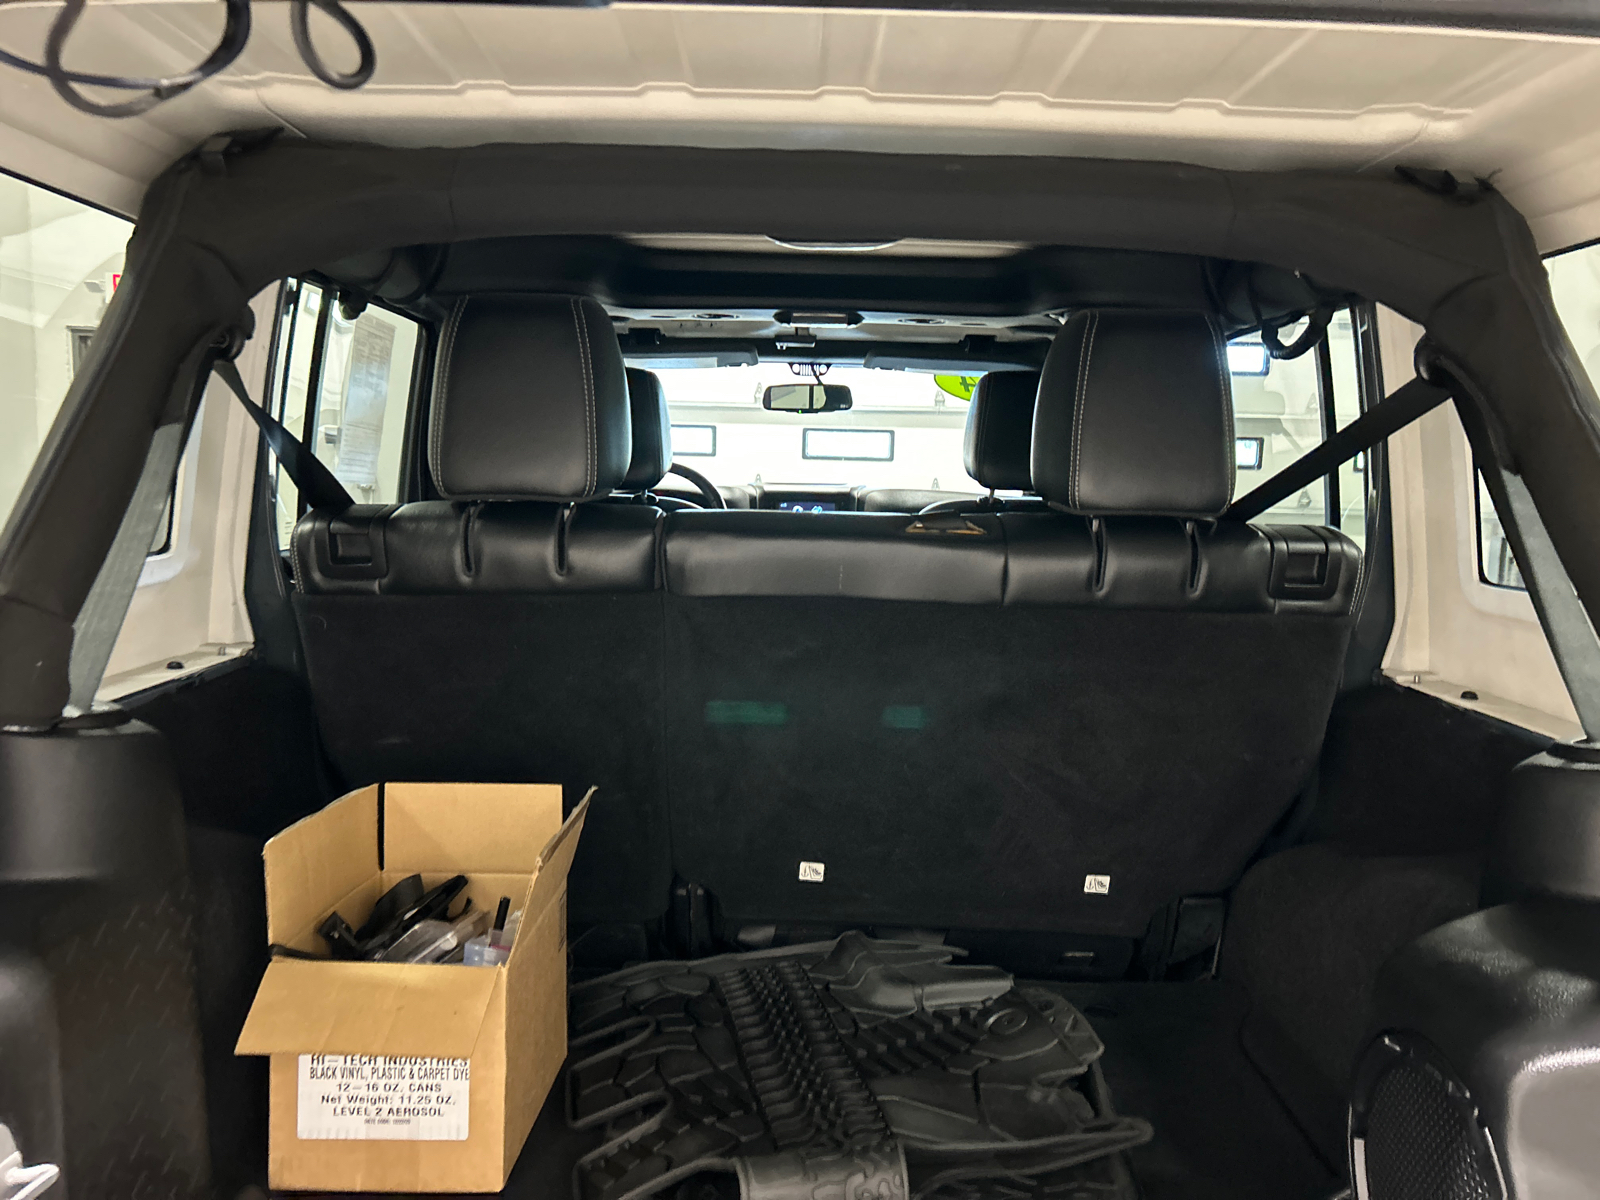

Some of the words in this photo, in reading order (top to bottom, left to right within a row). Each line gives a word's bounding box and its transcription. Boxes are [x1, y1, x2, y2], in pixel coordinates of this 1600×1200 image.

[309, 1066, 337, 1080] BLACK
[340, 1066, 368, 1081] VINYL,
[371, 1066, 406, 1080] PLASTIC
[408, 1067, 415, 1080] &
[417, 1067, 450, 1081] CARPET
[453, 1067, 470, 1081] DYE
[409, 1083, 442, 1093] CANS
[321, 1094, 341, 1104] Net
[347, 1094, 393, 1106] Weight:
[398, 1095, 432, 1105] 11.25
[333, 1106, 371, 1117] LEVEL
[375, 1107, 383, 1117] 2
[387, 1107, 445, 1118] AEROSOL
